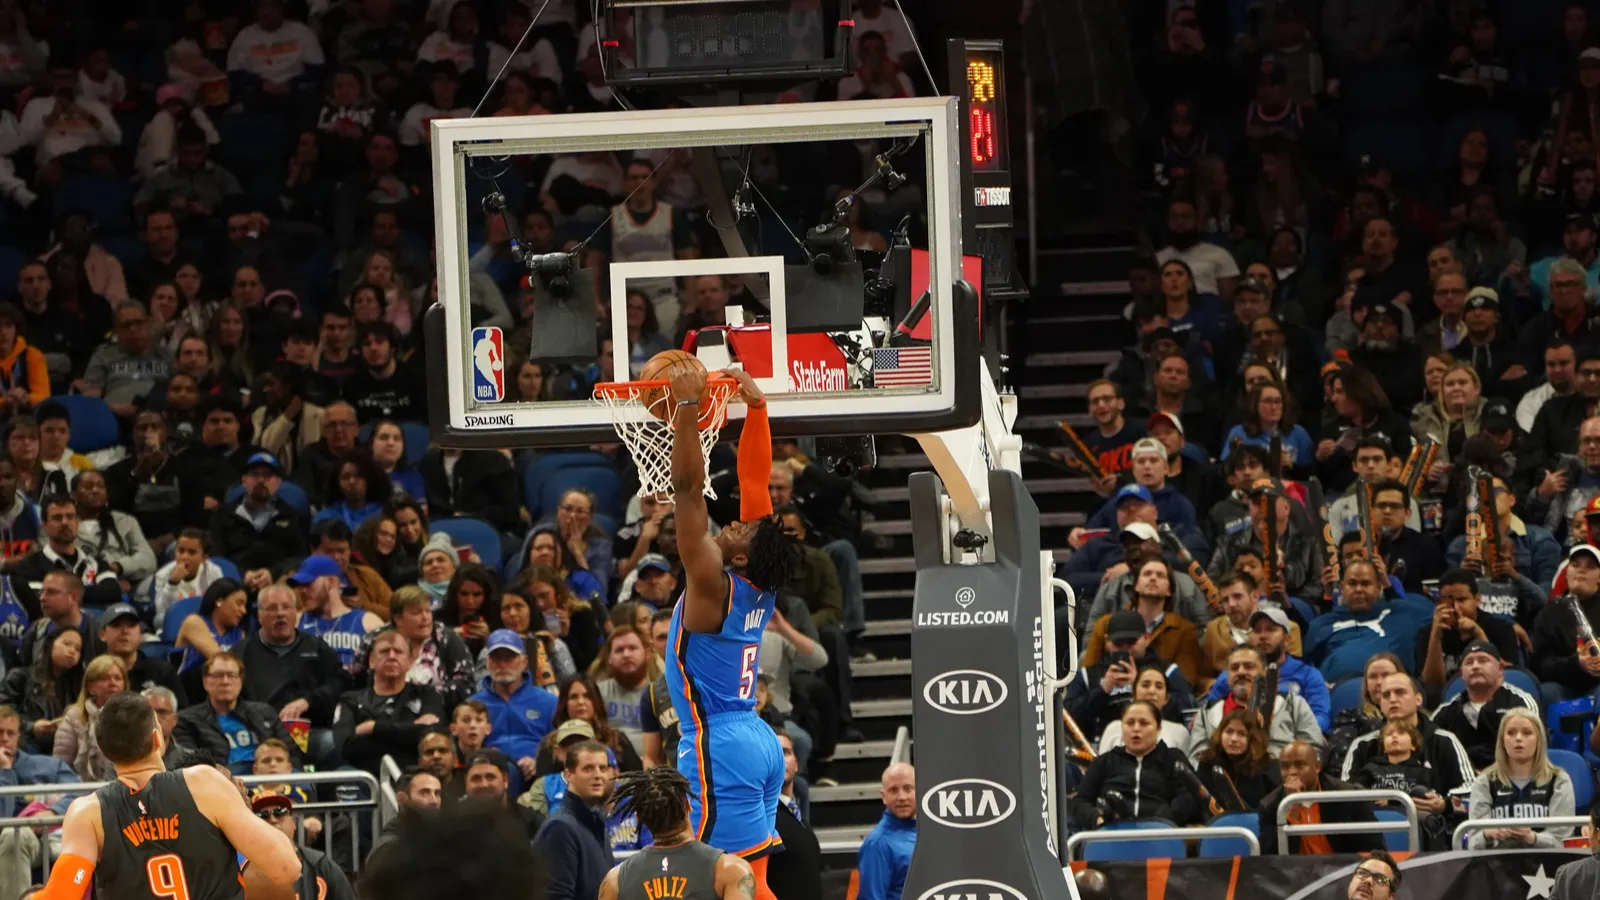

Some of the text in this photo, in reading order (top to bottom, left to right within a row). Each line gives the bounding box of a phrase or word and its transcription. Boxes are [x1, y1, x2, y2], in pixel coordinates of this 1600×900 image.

[985, 187, 1010, 206] TISSOT
[477, 385, 493, 398] NBA
[464, 413, 514, 428] SPALDING
[744, 608, 766, 632] DORT
[917, 610, 1009, 626] LISTED.COM
[738, 643, 760, 700] 5
[937, 679, 995, 705] KIA
[937, 789, 1001, 817] KIA
[122, 813, 179, 847] VUČEVIĆ
[146, 853, 191, 900] 9
[643, 875, 688, 900] FULTZ
